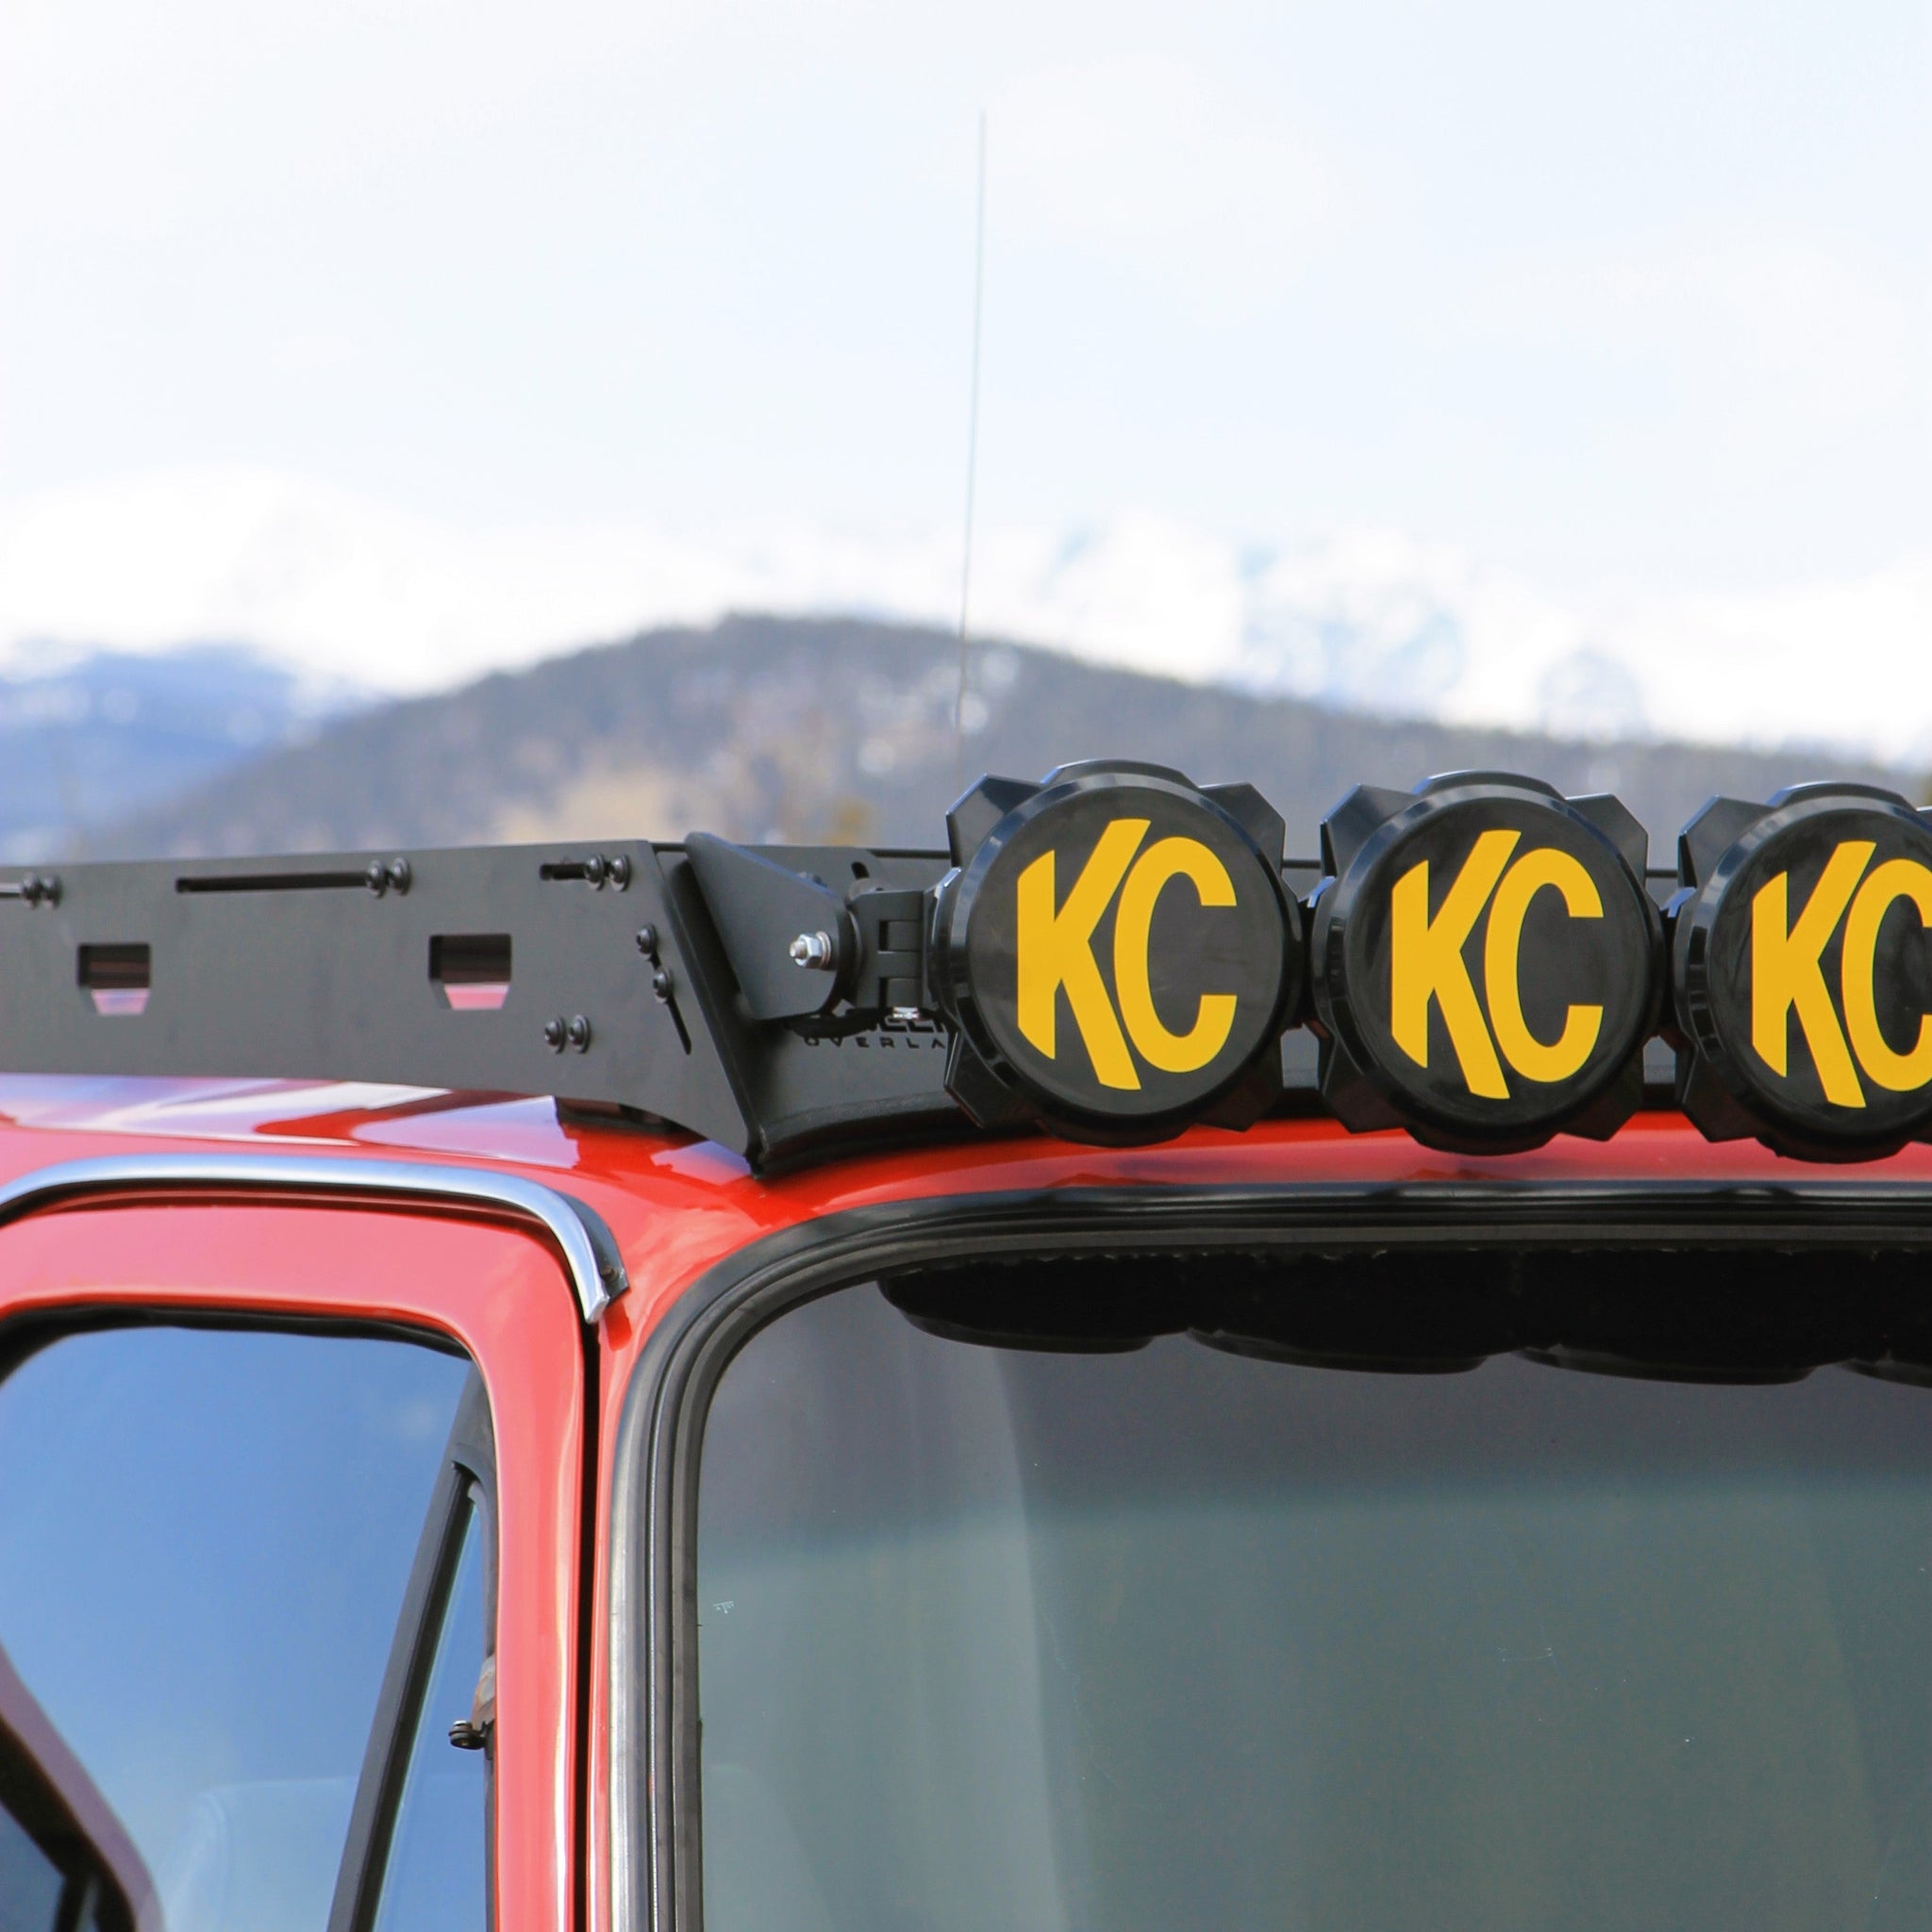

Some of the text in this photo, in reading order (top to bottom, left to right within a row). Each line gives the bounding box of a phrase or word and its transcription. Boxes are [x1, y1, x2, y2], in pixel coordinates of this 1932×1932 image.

[1017, 819, 1237, 1090] KC
[1391, 829, 1603, 1099] KC
[1752, 841, 1932, 1108] KC
